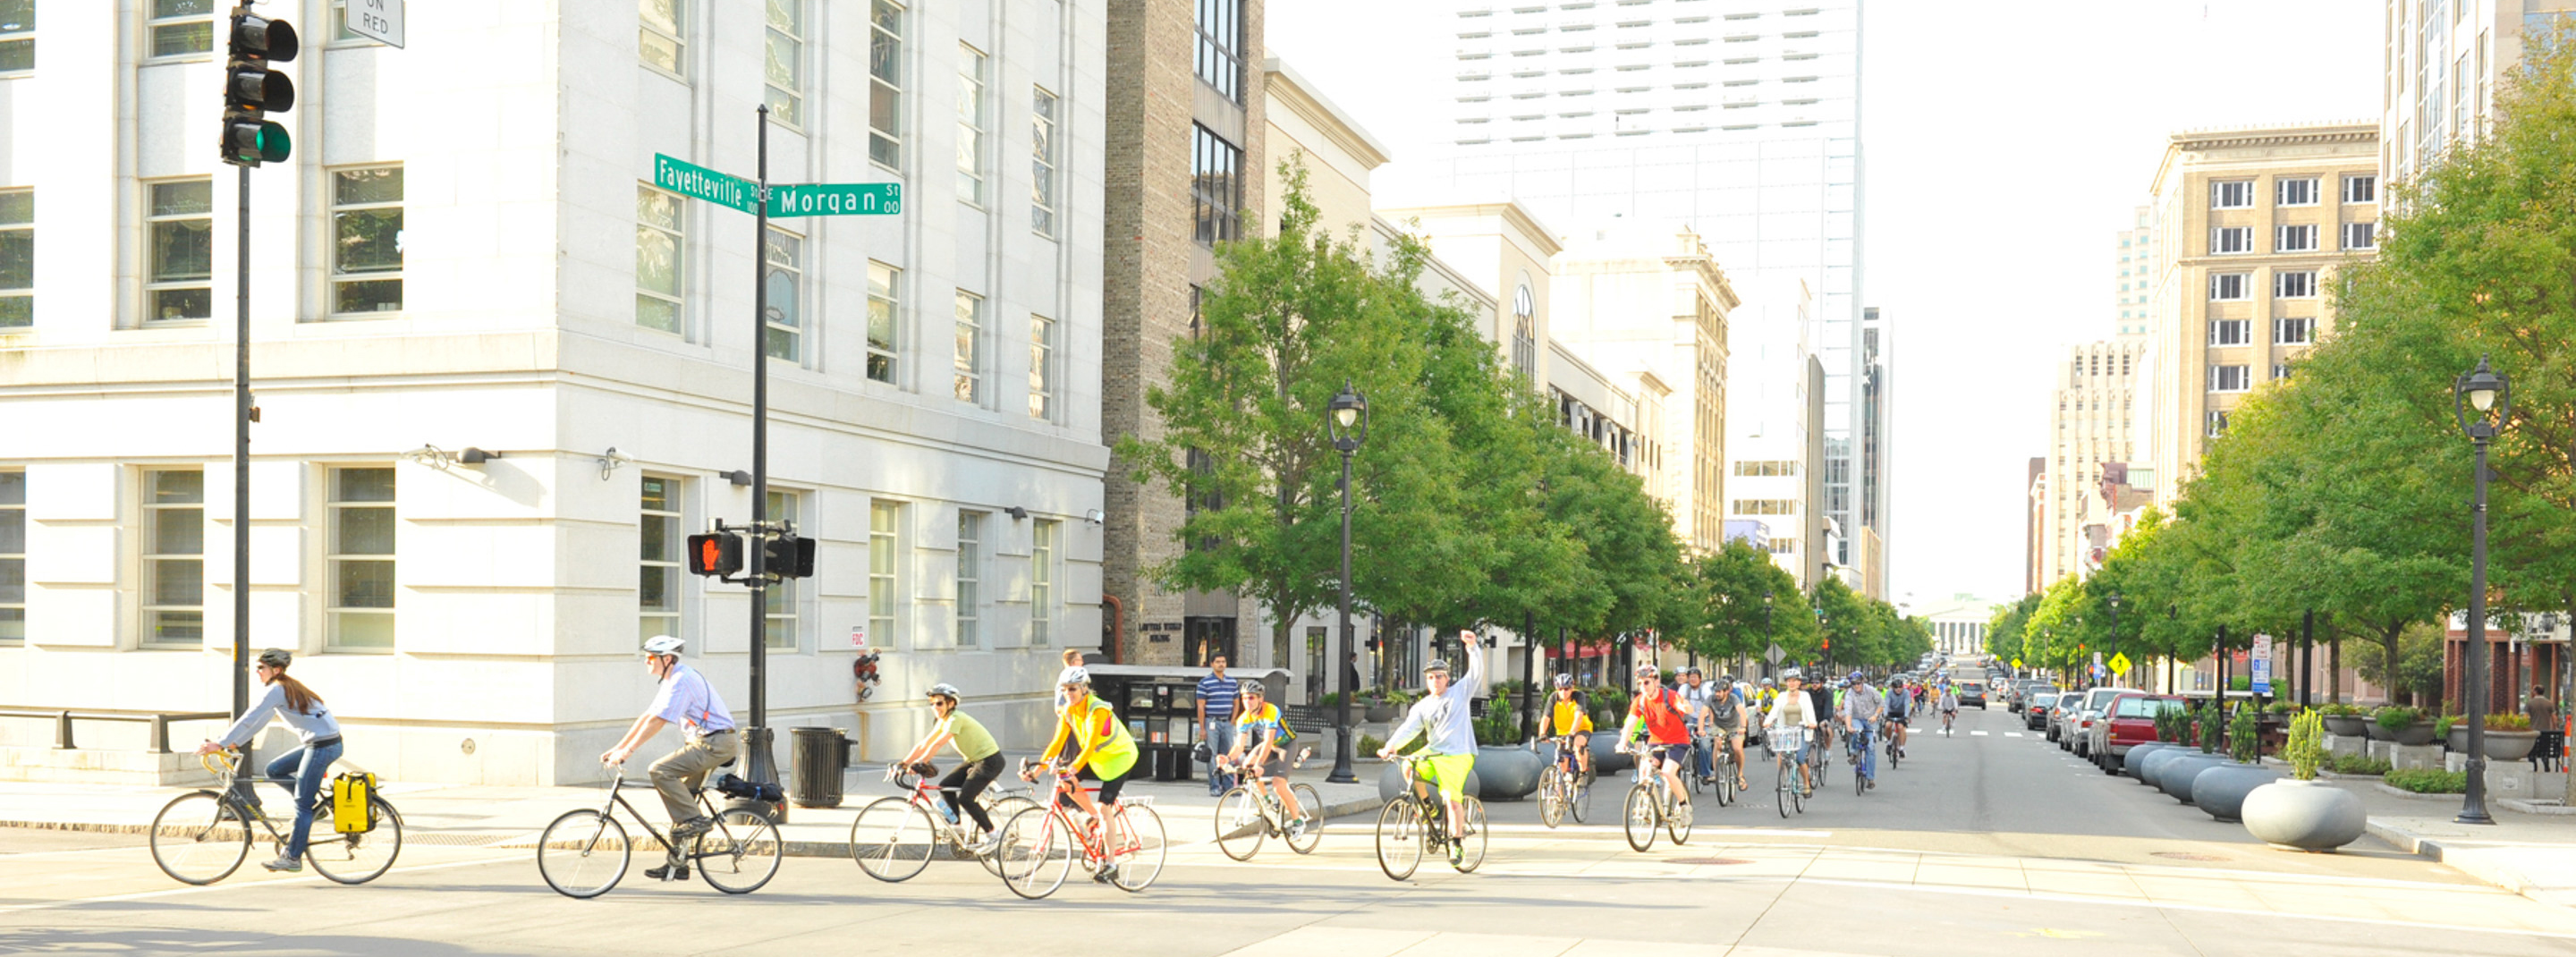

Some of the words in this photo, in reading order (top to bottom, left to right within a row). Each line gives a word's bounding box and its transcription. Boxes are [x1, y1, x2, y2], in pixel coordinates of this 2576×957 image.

[363, 13, 388, 34] RED
[660, 158, 741, 207] Fayetteville
[750, 185, 758, 199] St
[767, 188, 774, 200] E
[781, 186, 875, 214] Morgan
[886, 184, 899, 196] St
[884, 200, 899, 213] 00
[852, 633, 863, 645] FDC
